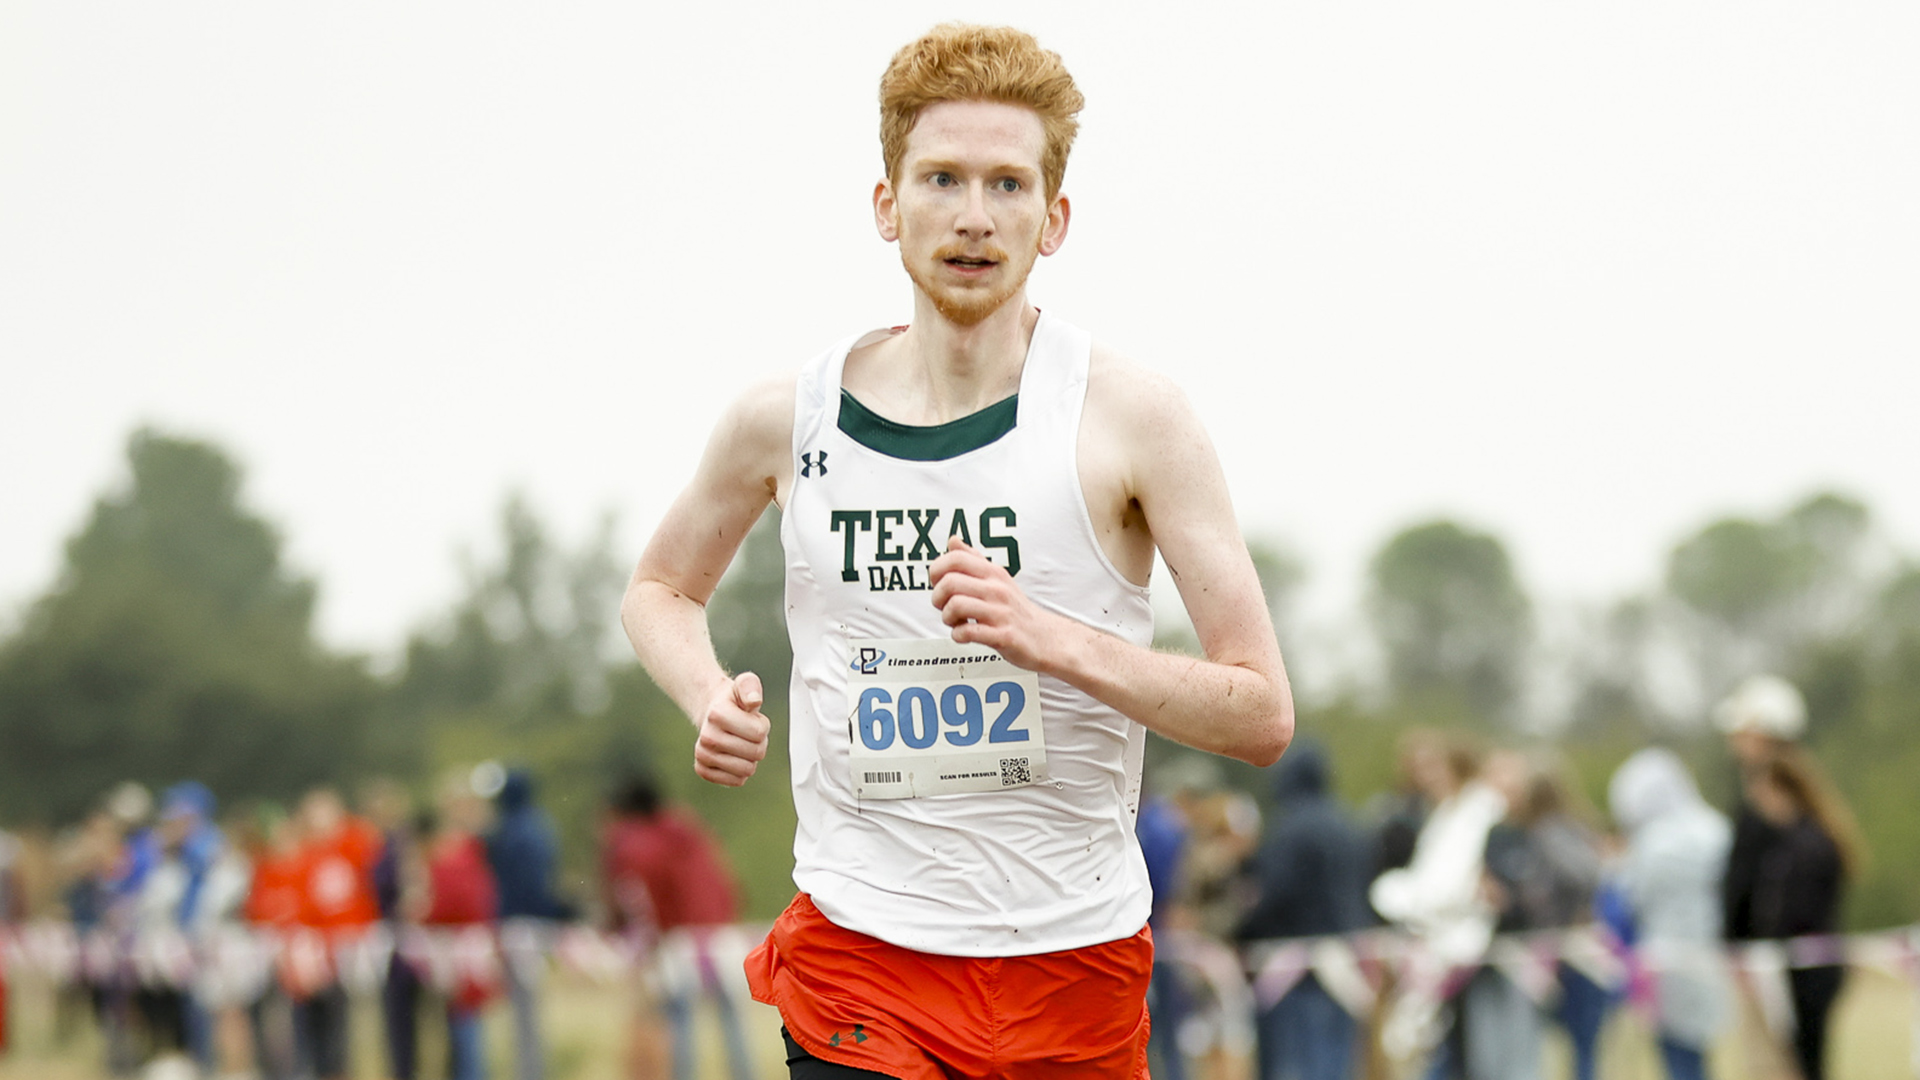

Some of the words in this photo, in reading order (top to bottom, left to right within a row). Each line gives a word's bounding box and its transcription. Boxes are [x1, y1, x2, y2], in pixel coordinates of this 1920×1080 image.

[830, 506, 1021, 582] TEXAS
[868, 565, 934, 591] DAL
[888, 654, 1003, 667] timeandmeasure.
[858, 681, 1030, 751] 6092
